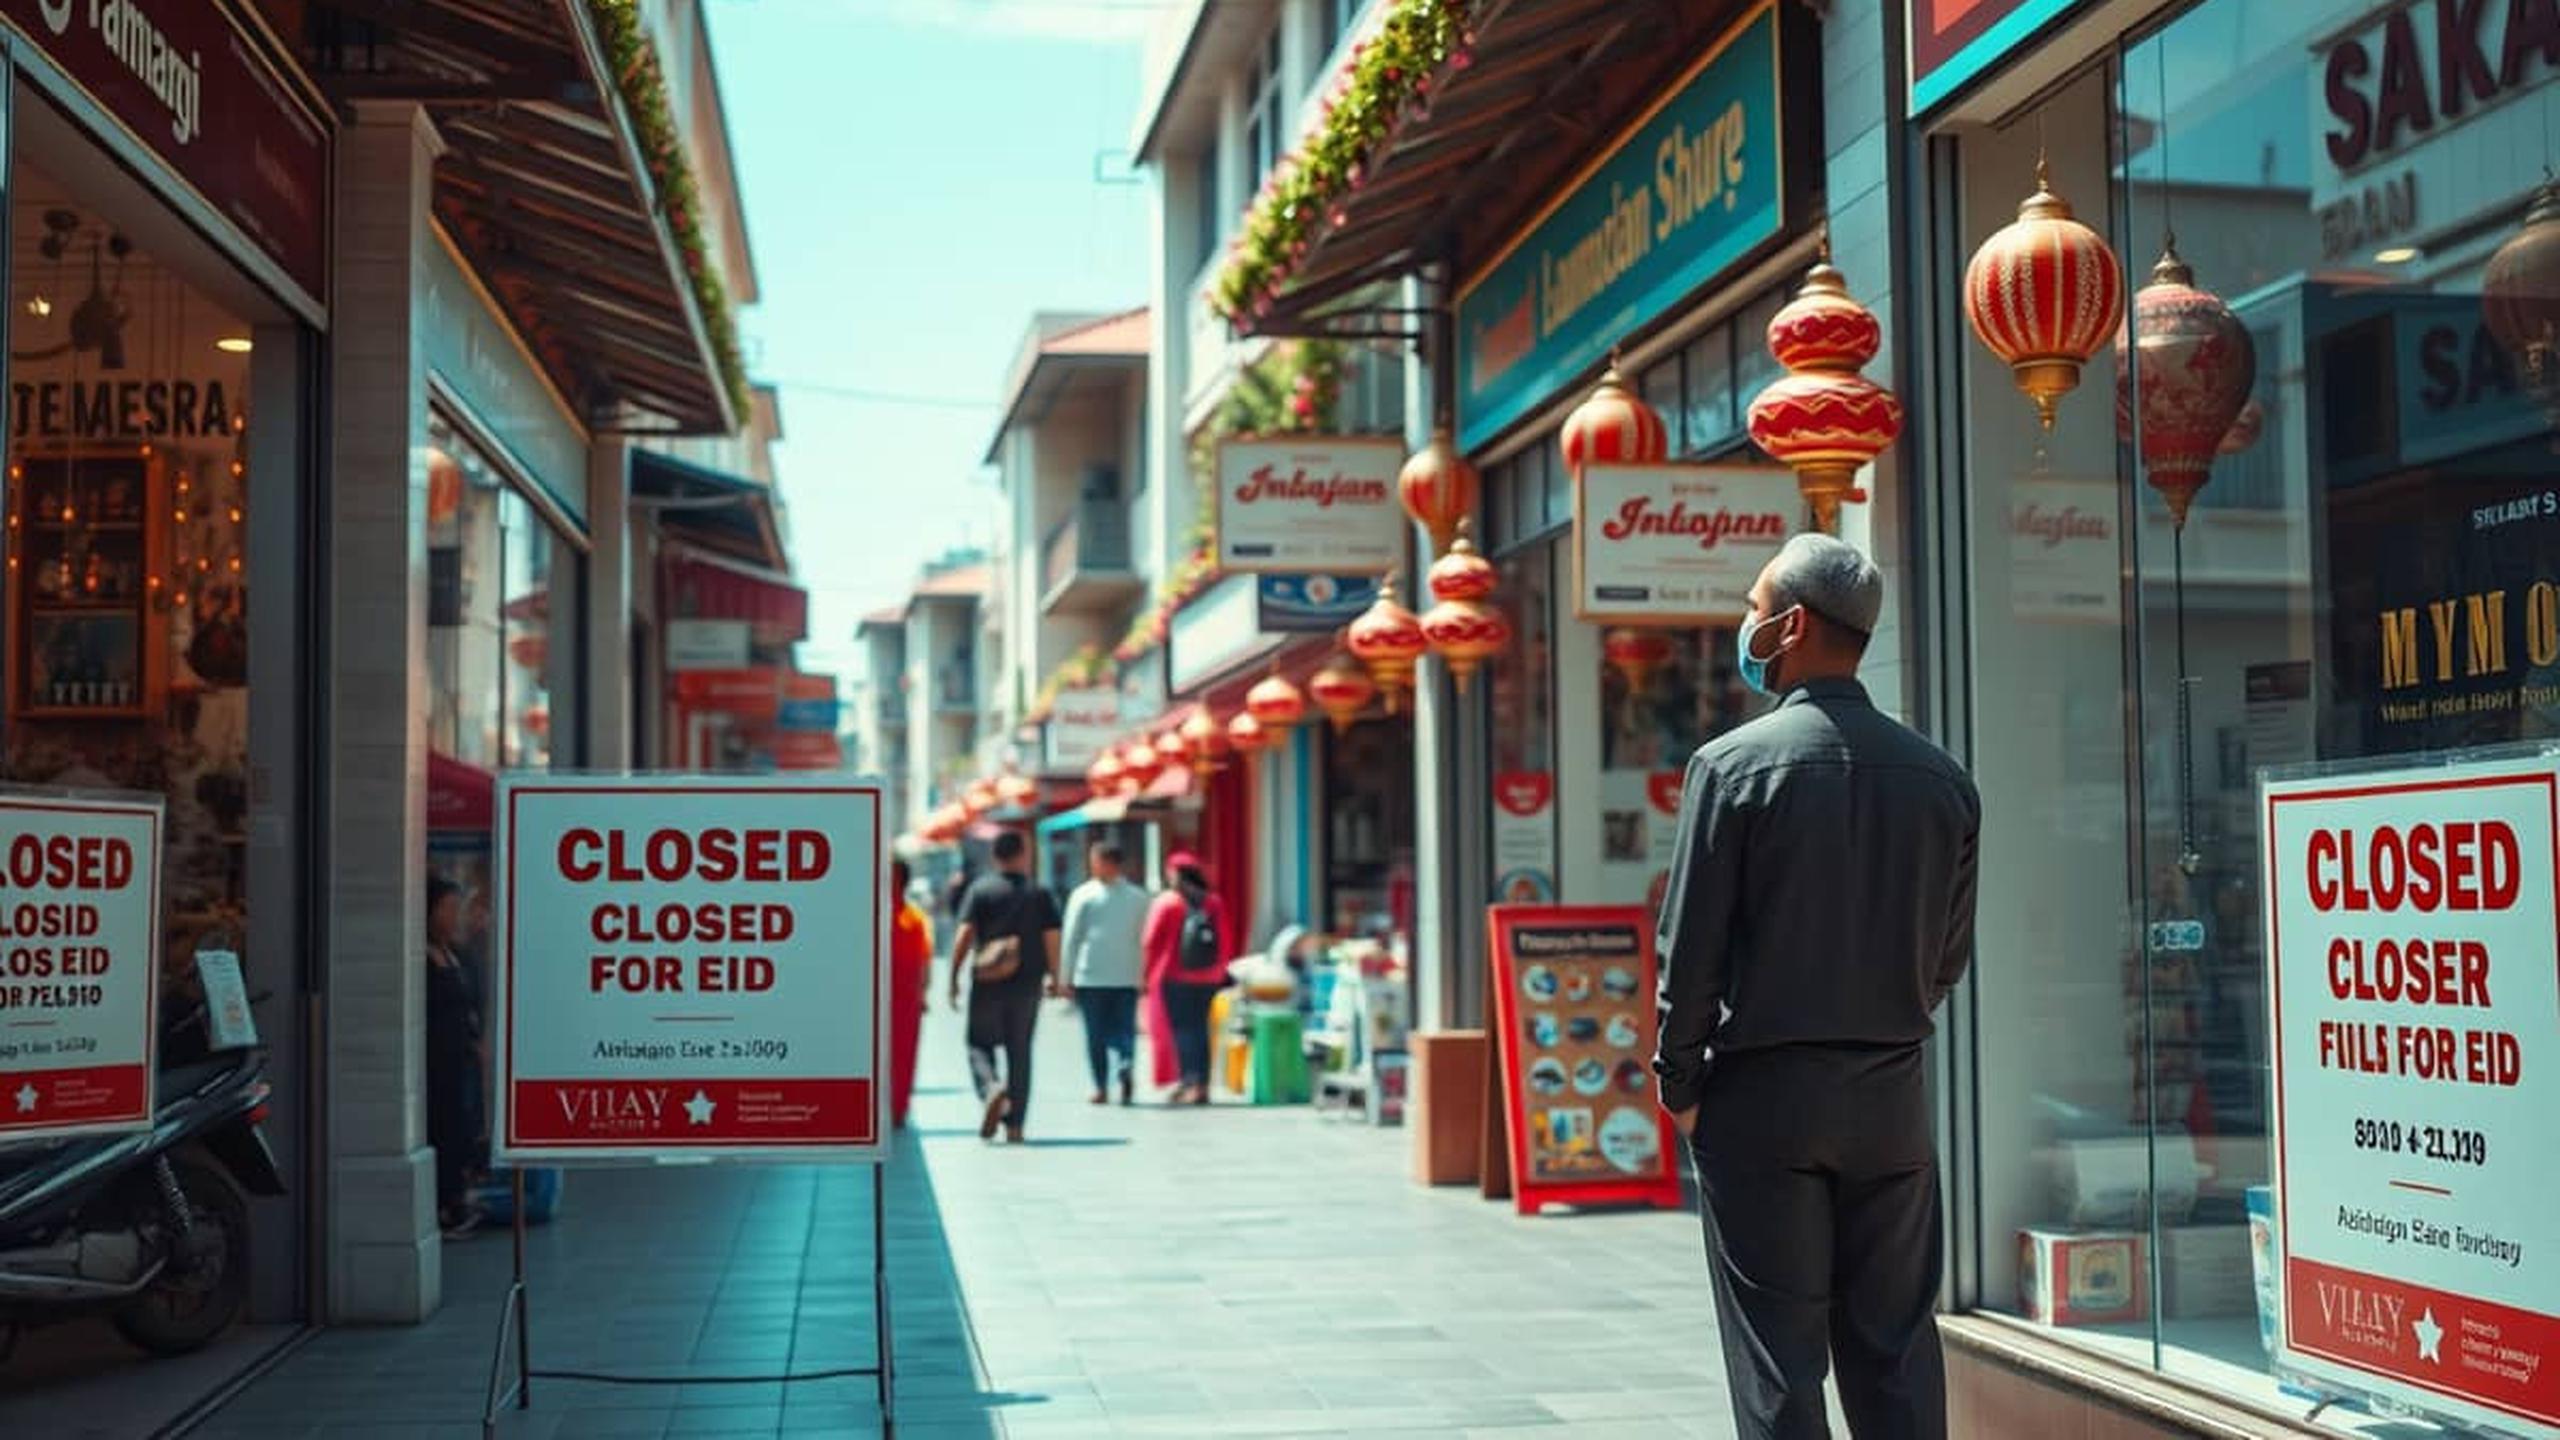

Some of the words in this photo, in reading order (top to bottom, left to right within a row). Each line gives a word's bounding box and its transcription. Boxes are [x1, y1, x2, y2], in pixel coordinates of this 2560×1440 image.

[0, 834, 133, 890] OSED
[557, 828, 831, 882] CLOSED
[2307, 820, 2520, 912] CLOSED
[591, 904, 794, 943] CLOSED
[62, 947, 110, 976] EID
[590, 957, 683, 993] FOR
[698, 957, 775, 993] EID
[2328, 938, 2491, 1007] CLOSER
[2397, 1026, 2457, 1081] FOR
[2466, 1030, 2520, 1086] EID
